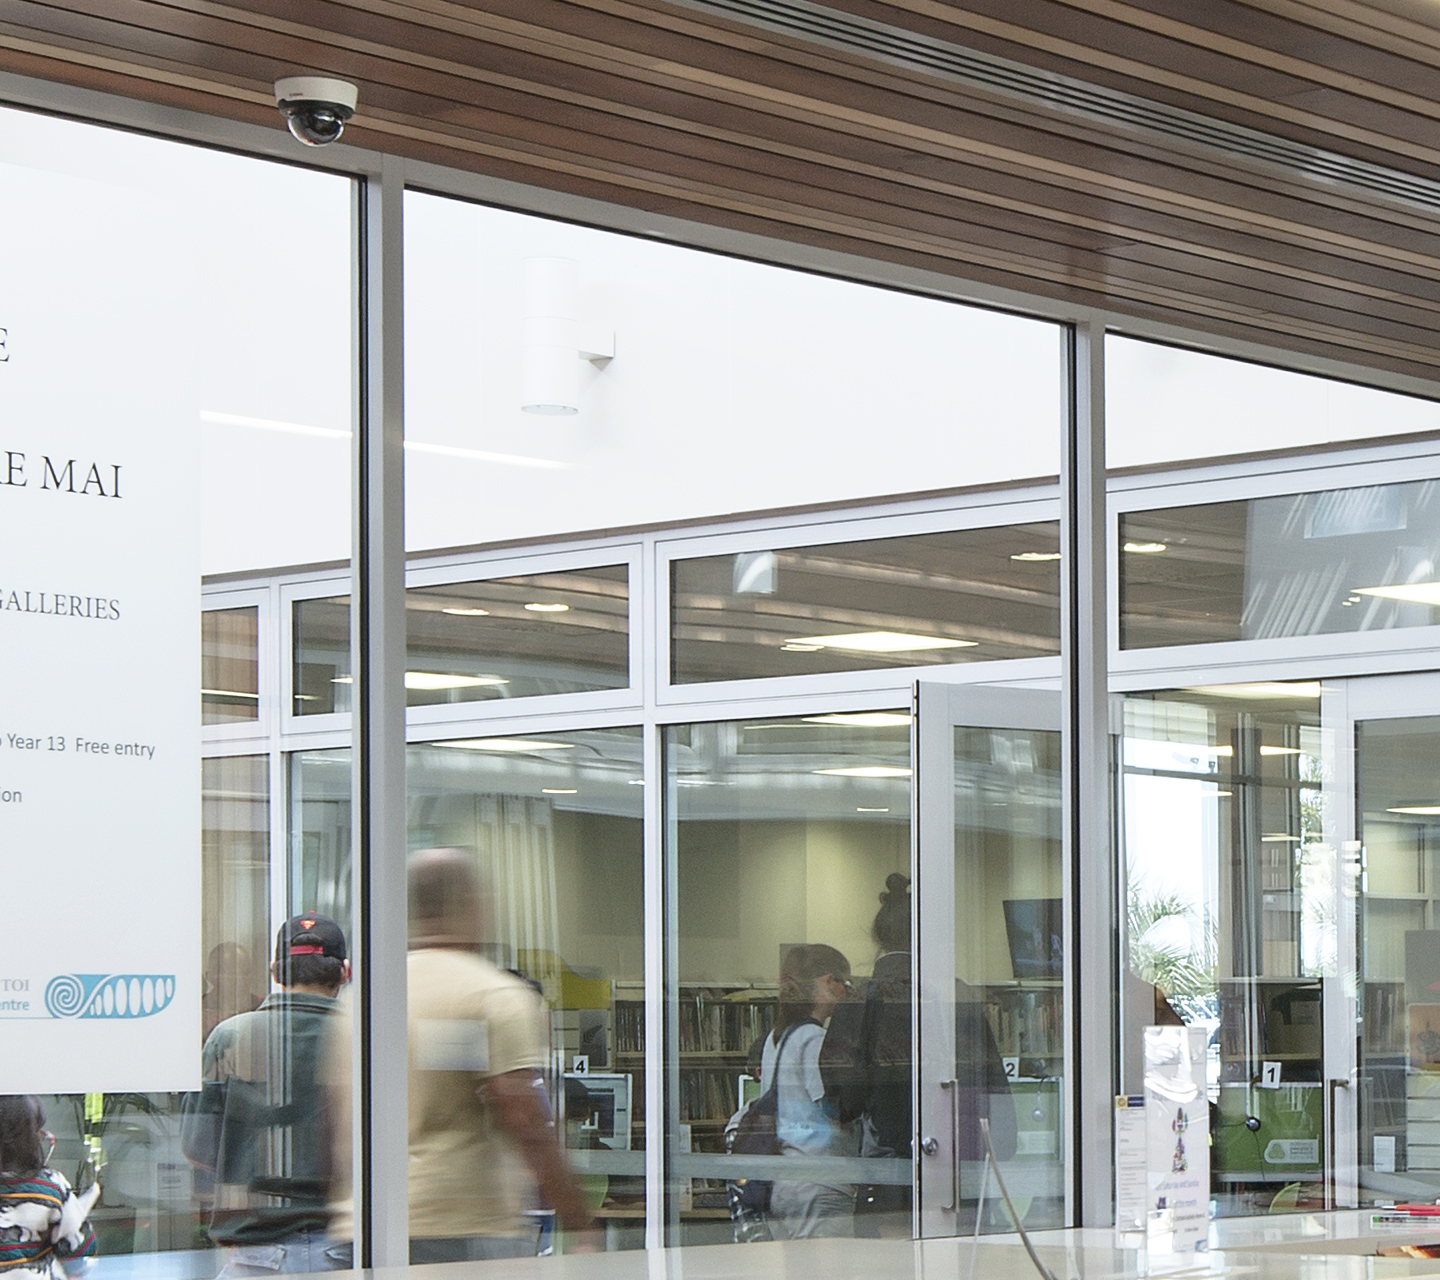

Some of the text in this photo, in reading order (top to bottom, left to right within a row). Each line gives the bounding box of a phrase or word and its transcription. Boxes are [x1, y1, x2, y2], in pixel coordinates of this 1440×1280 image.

[40, 455, 123, 499] MAI
[7, 733, 43, 751] Year
[47, 736, 67, 752] 13
[76, 737, 110, 755] Free
[114, 741, 156, 761] entry
[1, 979, 30, 992] TOI
[575, 1060, 586, 1073] 4
[1005, 1063, 1015, 1077] 2
[1267, 1067, 1275, 1082] 1
